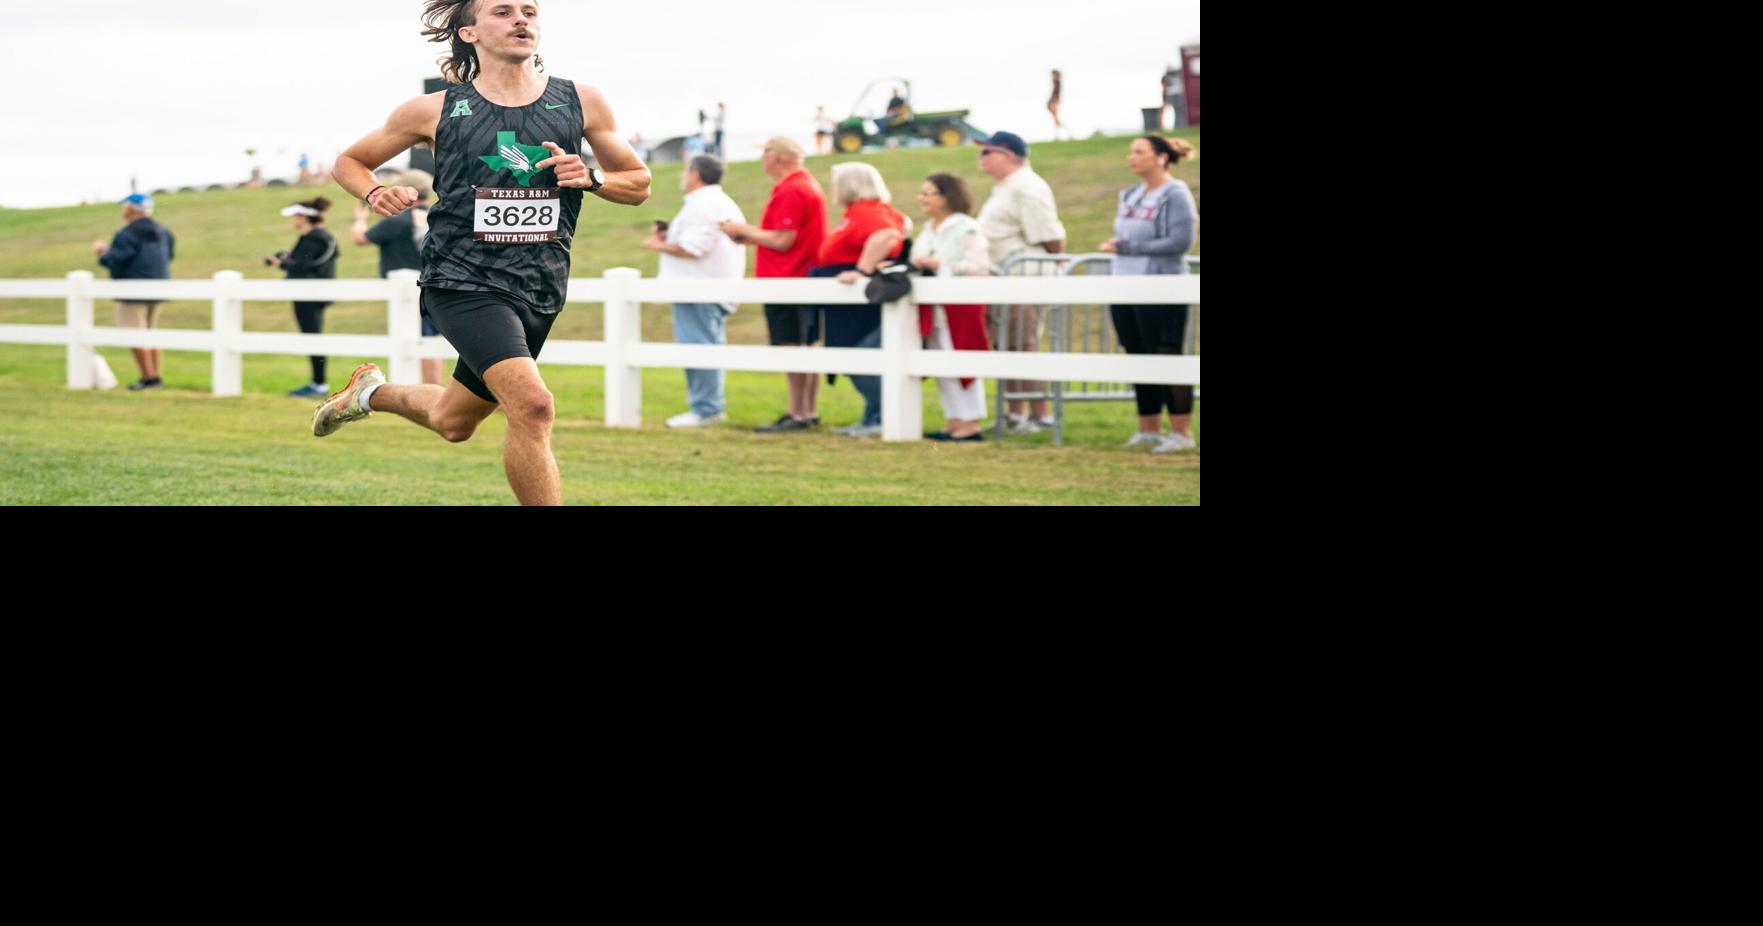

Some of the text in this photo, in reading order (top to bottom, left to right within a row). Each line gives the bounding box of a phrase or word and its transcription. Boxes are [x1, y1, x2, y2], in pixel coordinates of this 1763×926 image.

[450, 99, 473, 118] A
[491, 189, 549, 198] TEXAS A&M
[483, 206, 553, 226] 3628
[484, 233, 549, 242] INVITATIONAL
